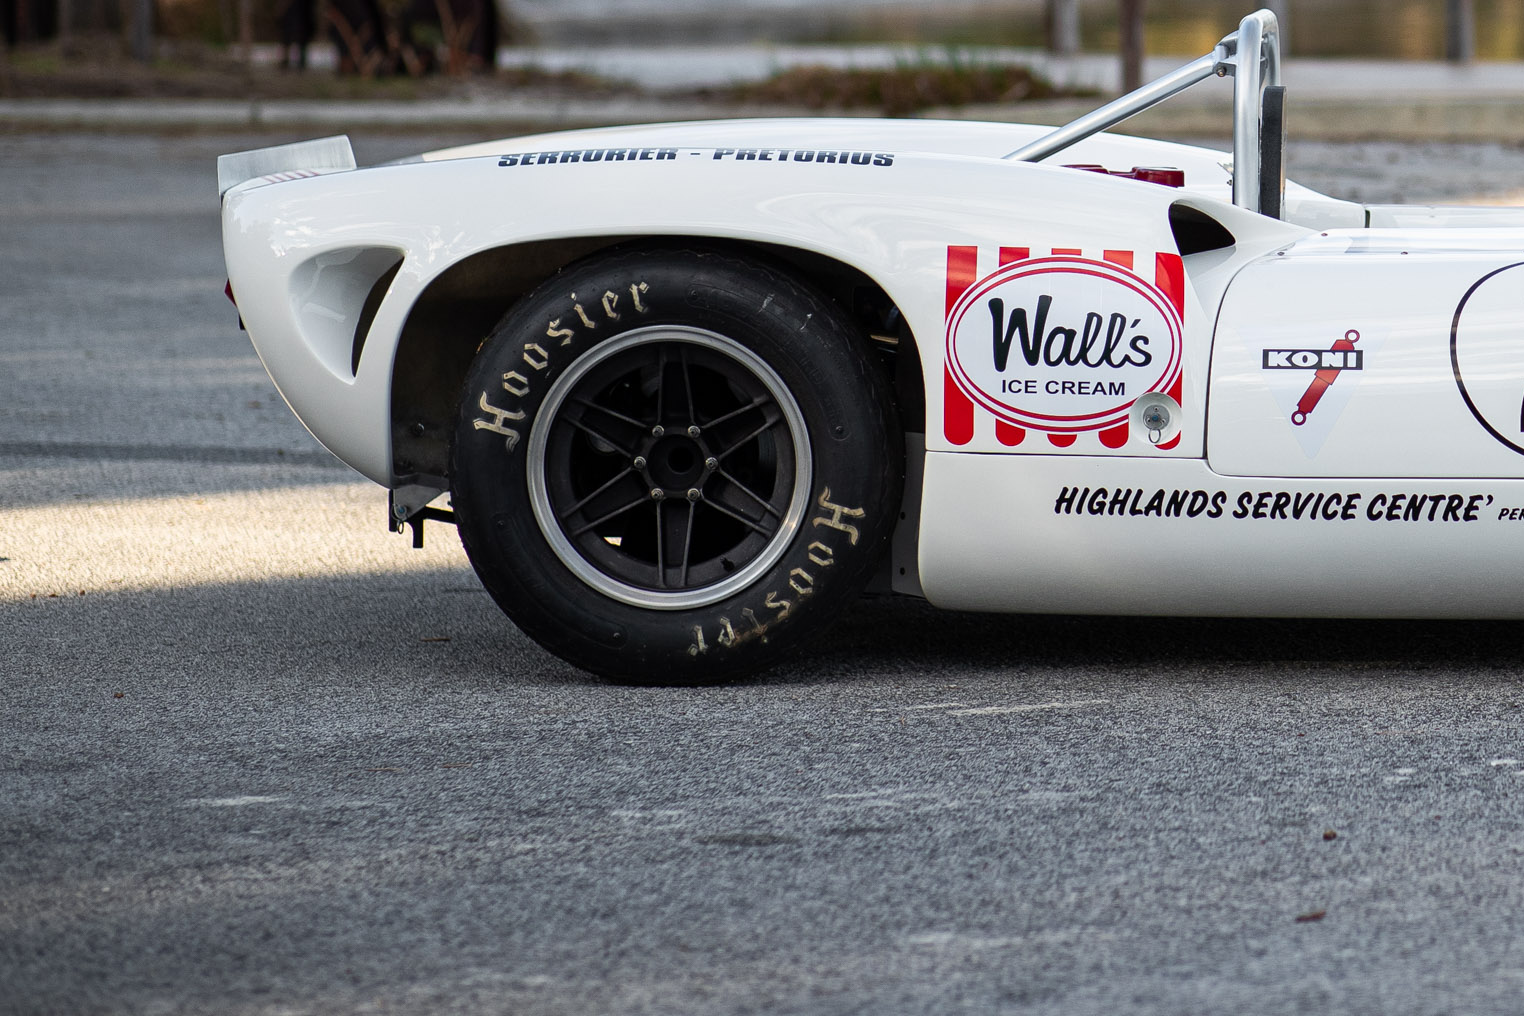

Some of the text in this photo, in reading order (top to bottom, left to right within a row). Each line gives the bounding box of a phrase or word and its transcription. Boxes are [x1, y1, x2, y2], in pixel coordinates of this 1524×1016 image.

[497, 147, 679, 167] SERRURIER
[712, 148, 895, 167] PRETORIUS
[988, 294, 1153, 373] Wall's
[473, 281, 649, 454] Hoosier
[1267, 350, 1358, 368] KONI
[1001, 379, 1127, 397] ICE CREAM
[1054, 486, 1228, 519] HIGHLANDS
[1232, 490, 1362, 522] SERVICE
